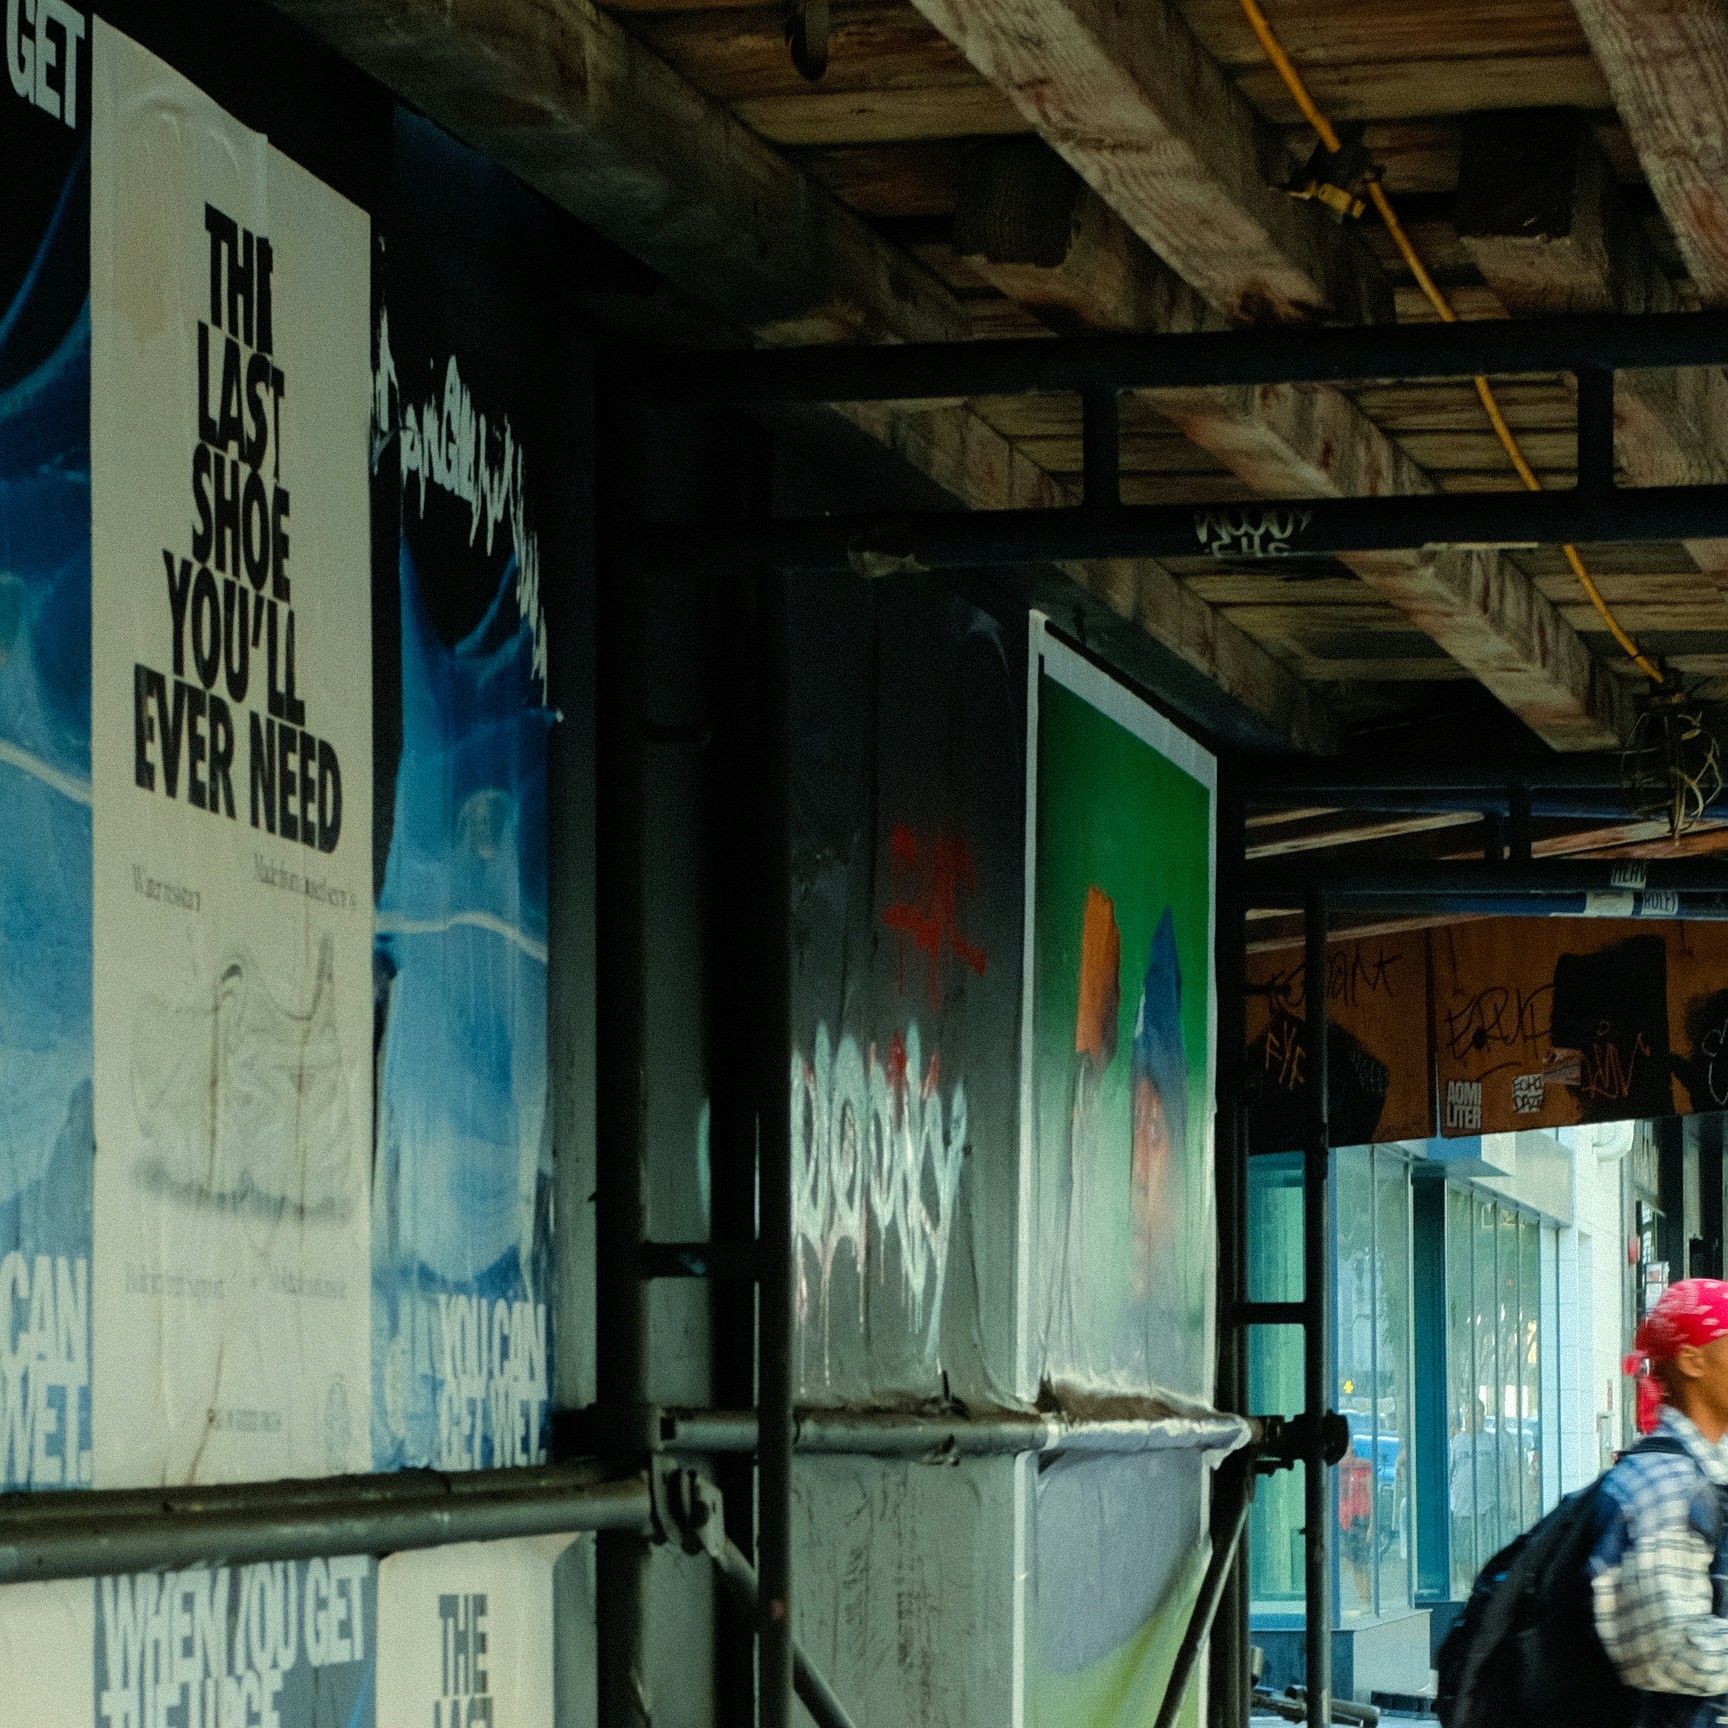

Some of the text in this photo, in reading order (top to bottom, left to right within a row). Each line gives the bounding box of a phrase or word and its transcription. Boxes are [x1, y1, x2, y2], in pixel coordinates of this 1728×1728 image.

[6, 0, 85, 129] GET
[197, 319, 285, 482] LAST
[192, 440, 291, 604] SHOE
[163, 548, 305, 728] YOU'LL
[134, 661, 343, 854] EVER NEED
[438, 1293, 546, 1398] YOU CAN
[439, 1373, 486, 1472] GET
[100, 1553, 370, 1694] WHEN YOU GET
[438, 1593, 487, 1698] THE
